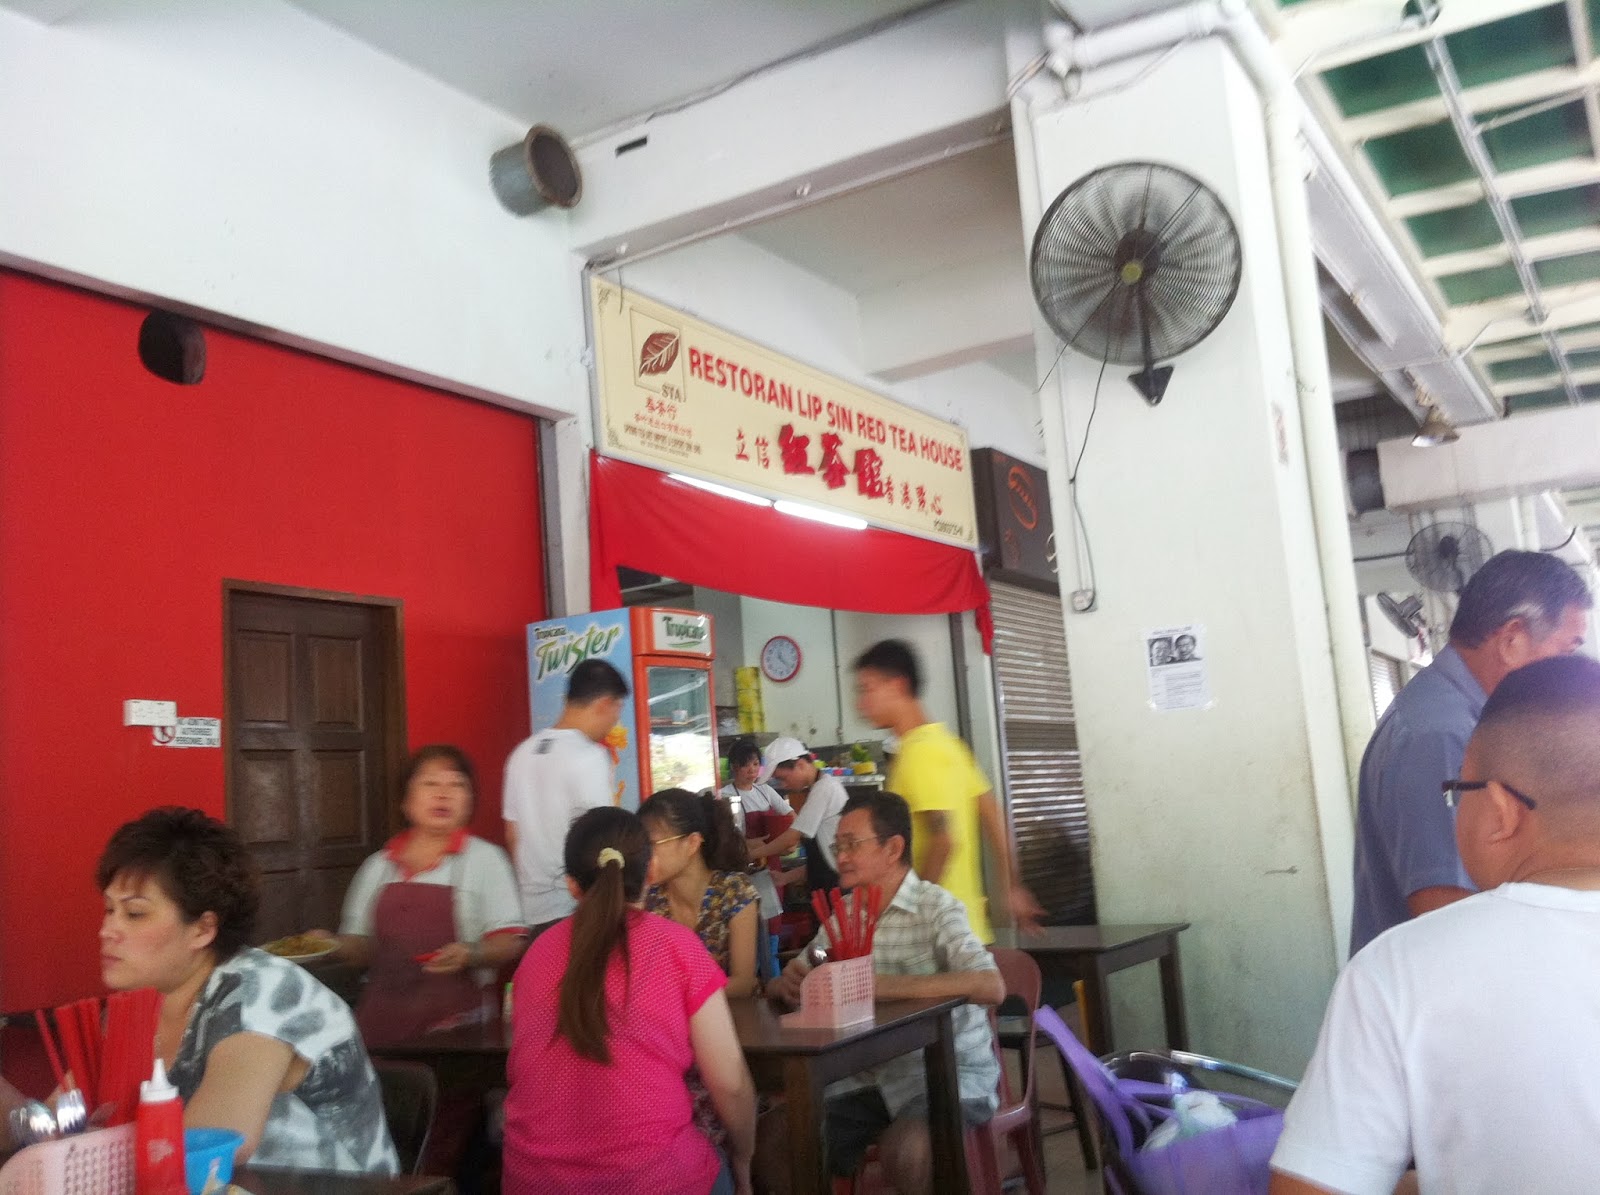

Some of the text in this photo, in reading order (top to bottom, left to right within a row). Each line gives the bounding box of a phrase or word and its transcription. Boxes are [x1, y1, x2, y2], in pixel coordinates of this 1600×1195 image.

[689, 347, 963, 472] RESTORAN LIP SIN RED TEA HOUSE
[536, 625, 620, 681] Twister
